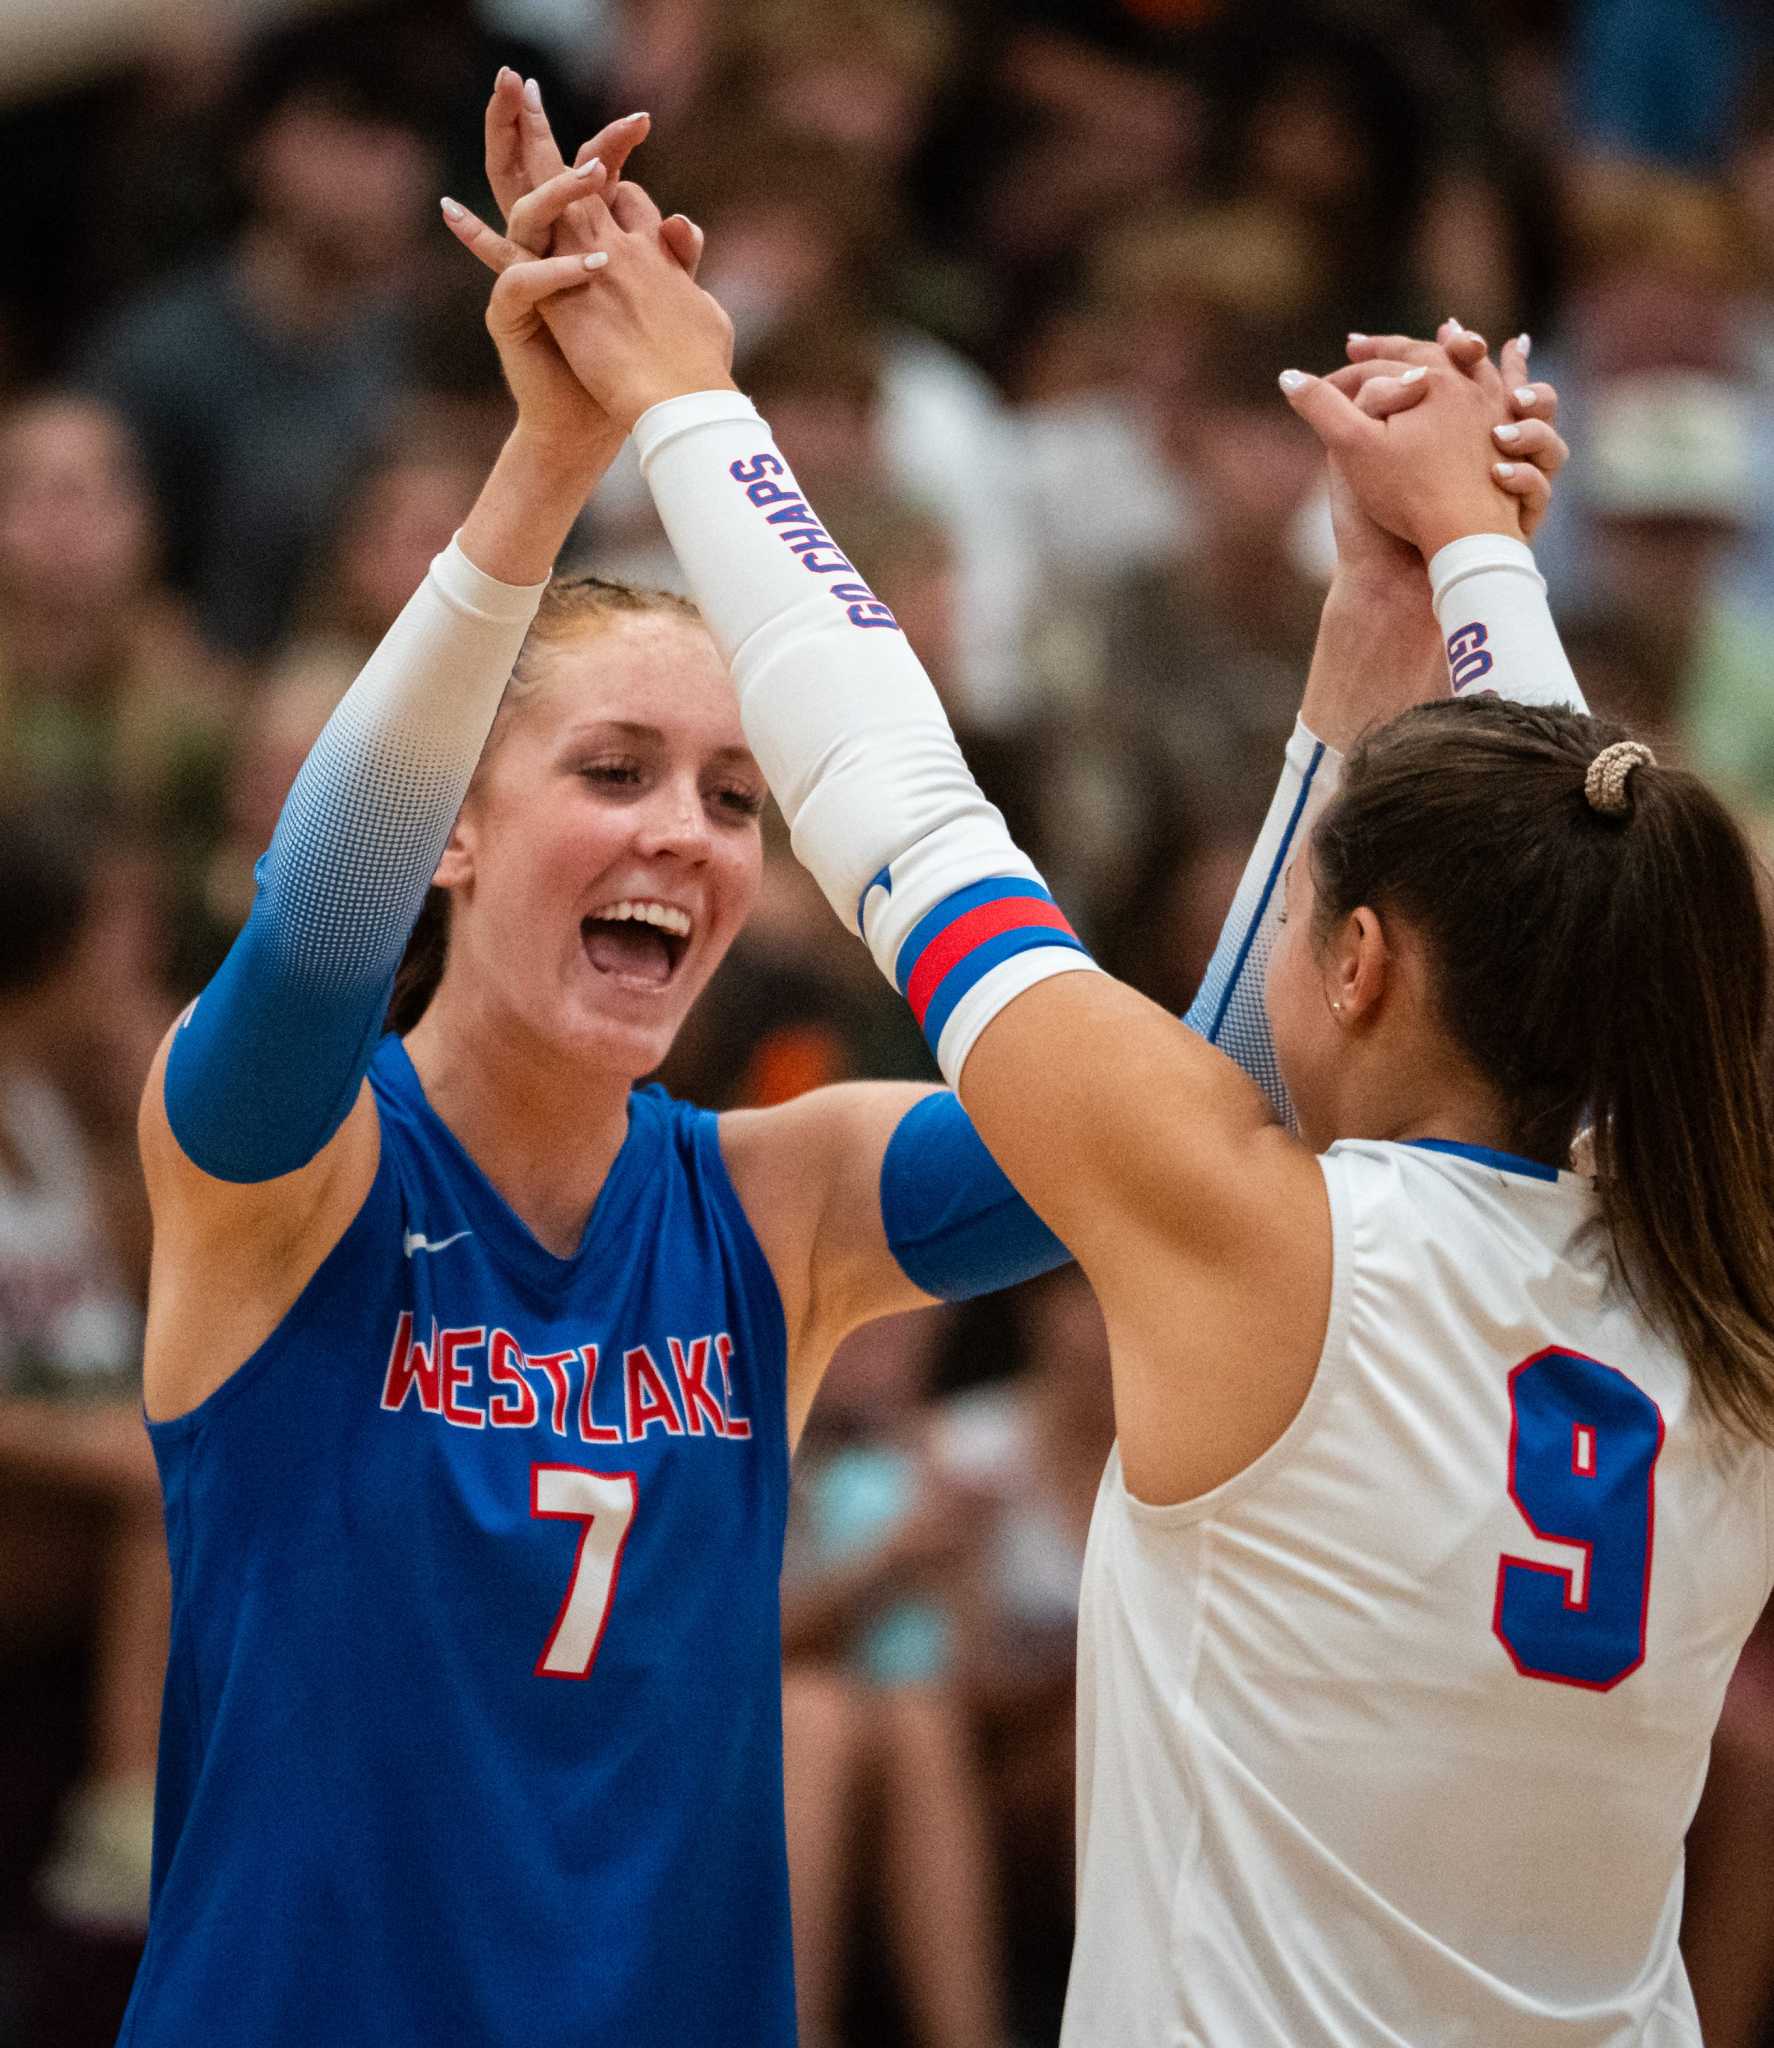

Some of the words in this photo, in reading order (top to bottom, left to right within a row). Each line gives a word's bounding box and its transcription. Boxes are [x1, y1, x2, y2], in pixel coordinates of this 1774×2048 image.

[729, 453, 855, 573] CHAPS
[830, 583, 900, 631] GO
[1446, 621, 1493, 692] GO
[530, 1460, 640, 1681] 7
[1491, 1344, 1666, 1694] 9
